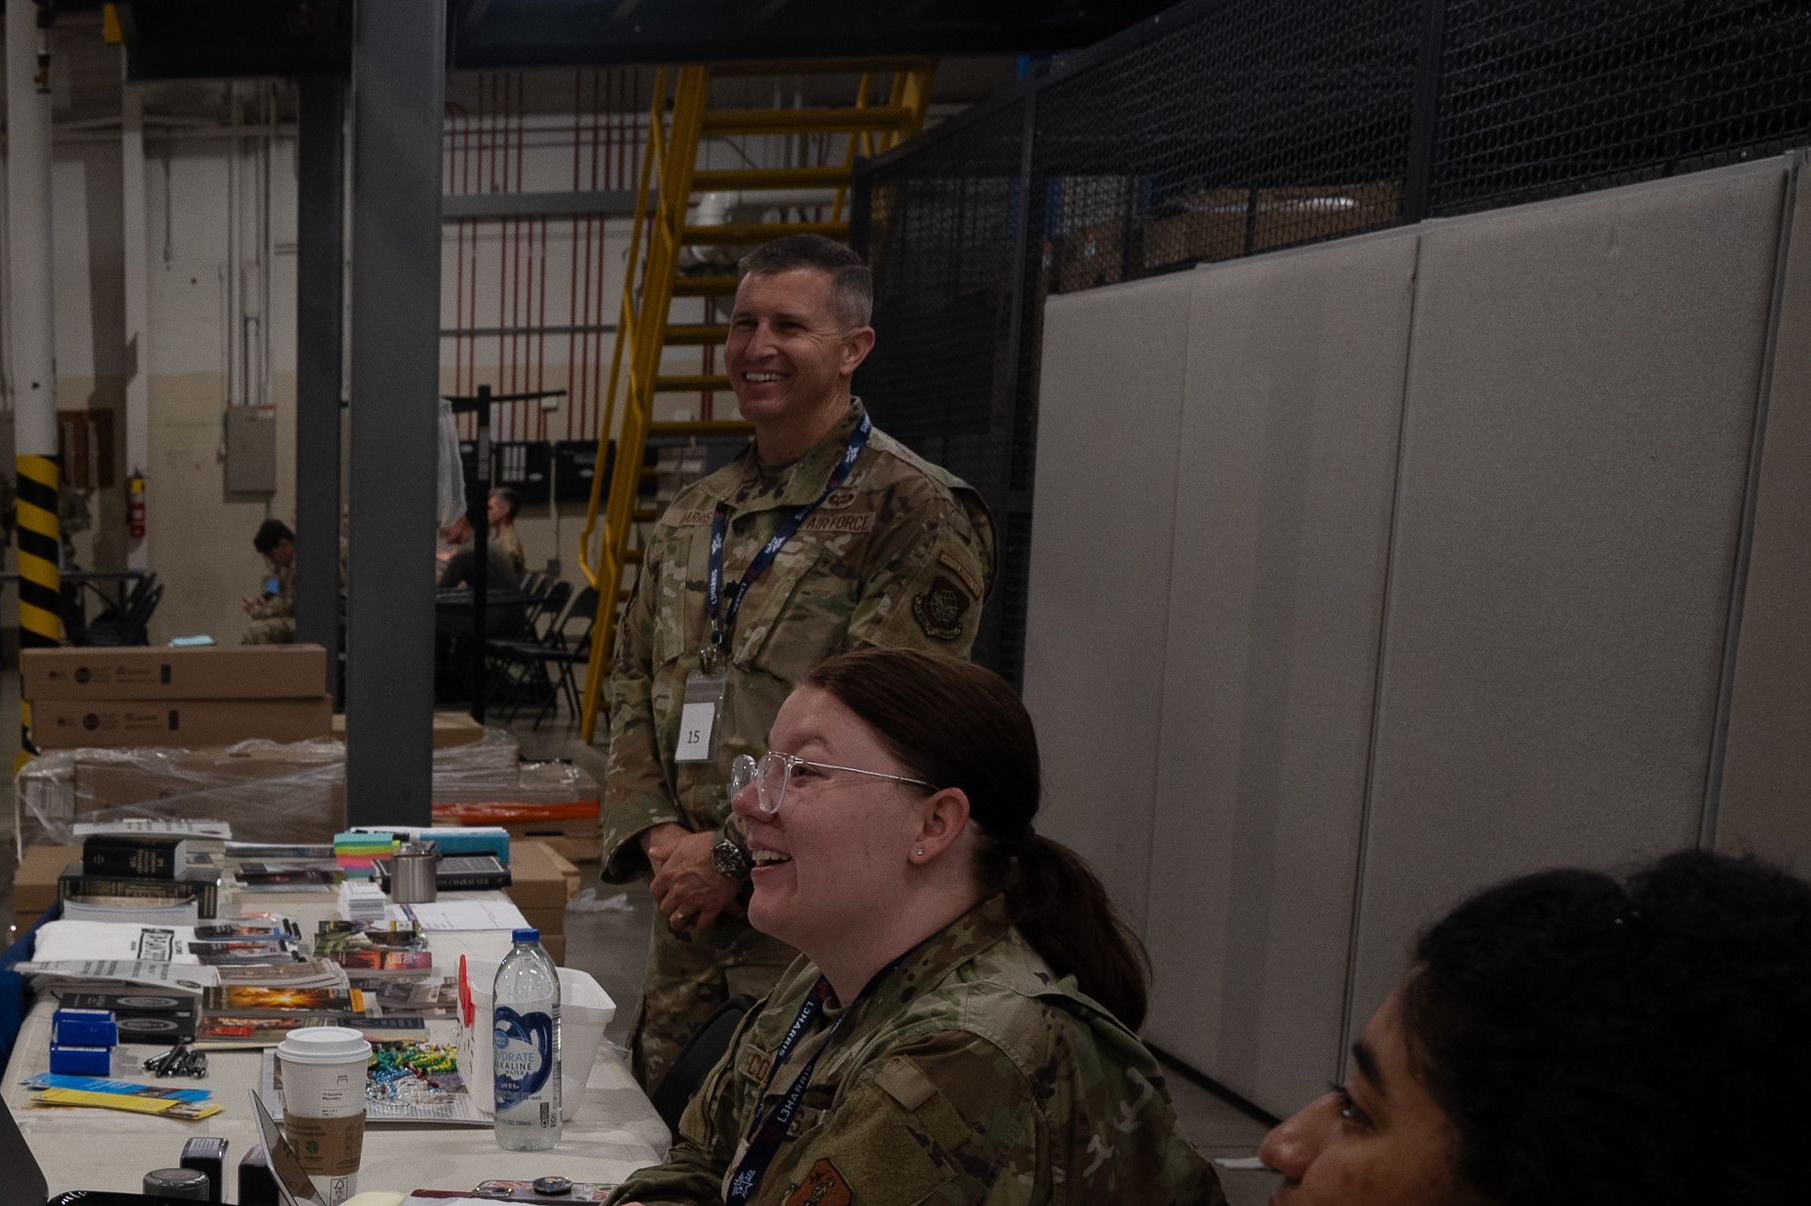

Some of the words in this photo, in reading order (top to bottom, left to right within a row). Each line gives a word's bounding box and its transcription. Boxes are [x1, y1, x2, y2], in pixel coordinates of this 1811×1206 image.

[805, 516, 829, 530] AIR
[827, 514, 870, 531] FORCE
[687, 729, 700, 744] 15
[448, 877, 490, 886] CHARACTER
[777, 1000, 815, 1057] L3HARRIS
[776, 1063, 813, 1124] L3HARRIS
